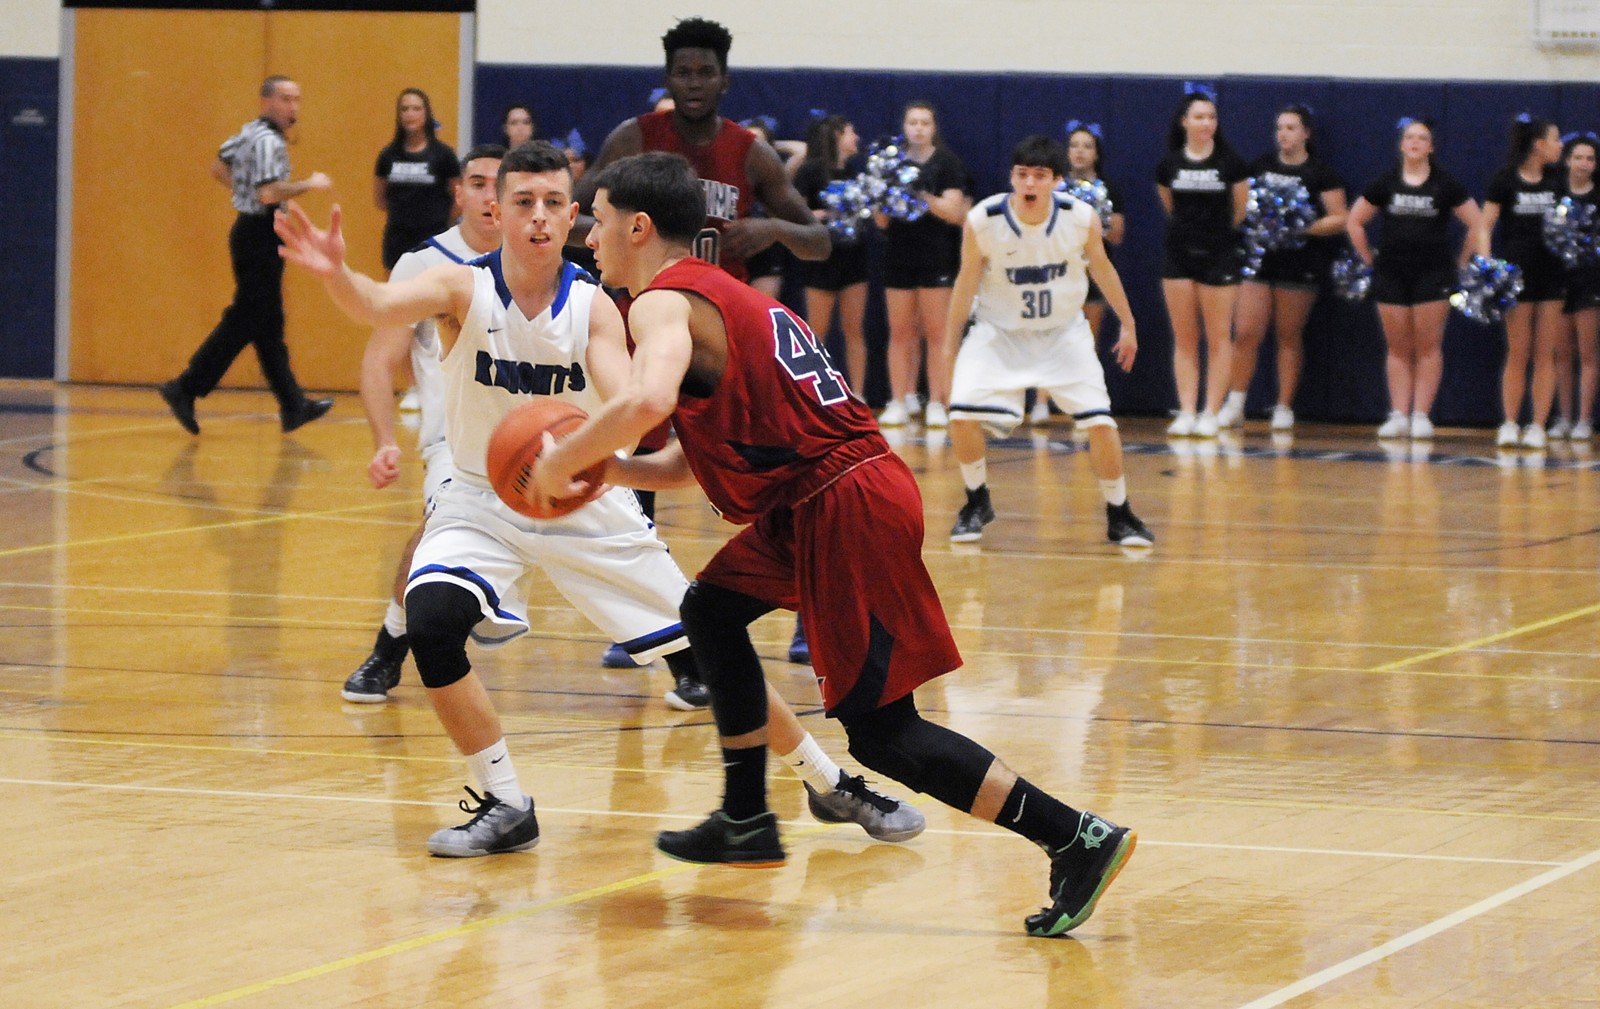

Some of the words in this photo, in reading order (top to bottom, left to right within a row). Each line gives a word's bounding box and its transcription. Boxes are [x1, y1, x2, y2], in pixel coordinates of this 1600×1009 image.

[1179, 169, 1219, 181] MSMC
[1394, 193, 1434, 209] MSMC
[1518, 191, 1556, 205] MSMC
[1021, 288, 1052, 319] 30
